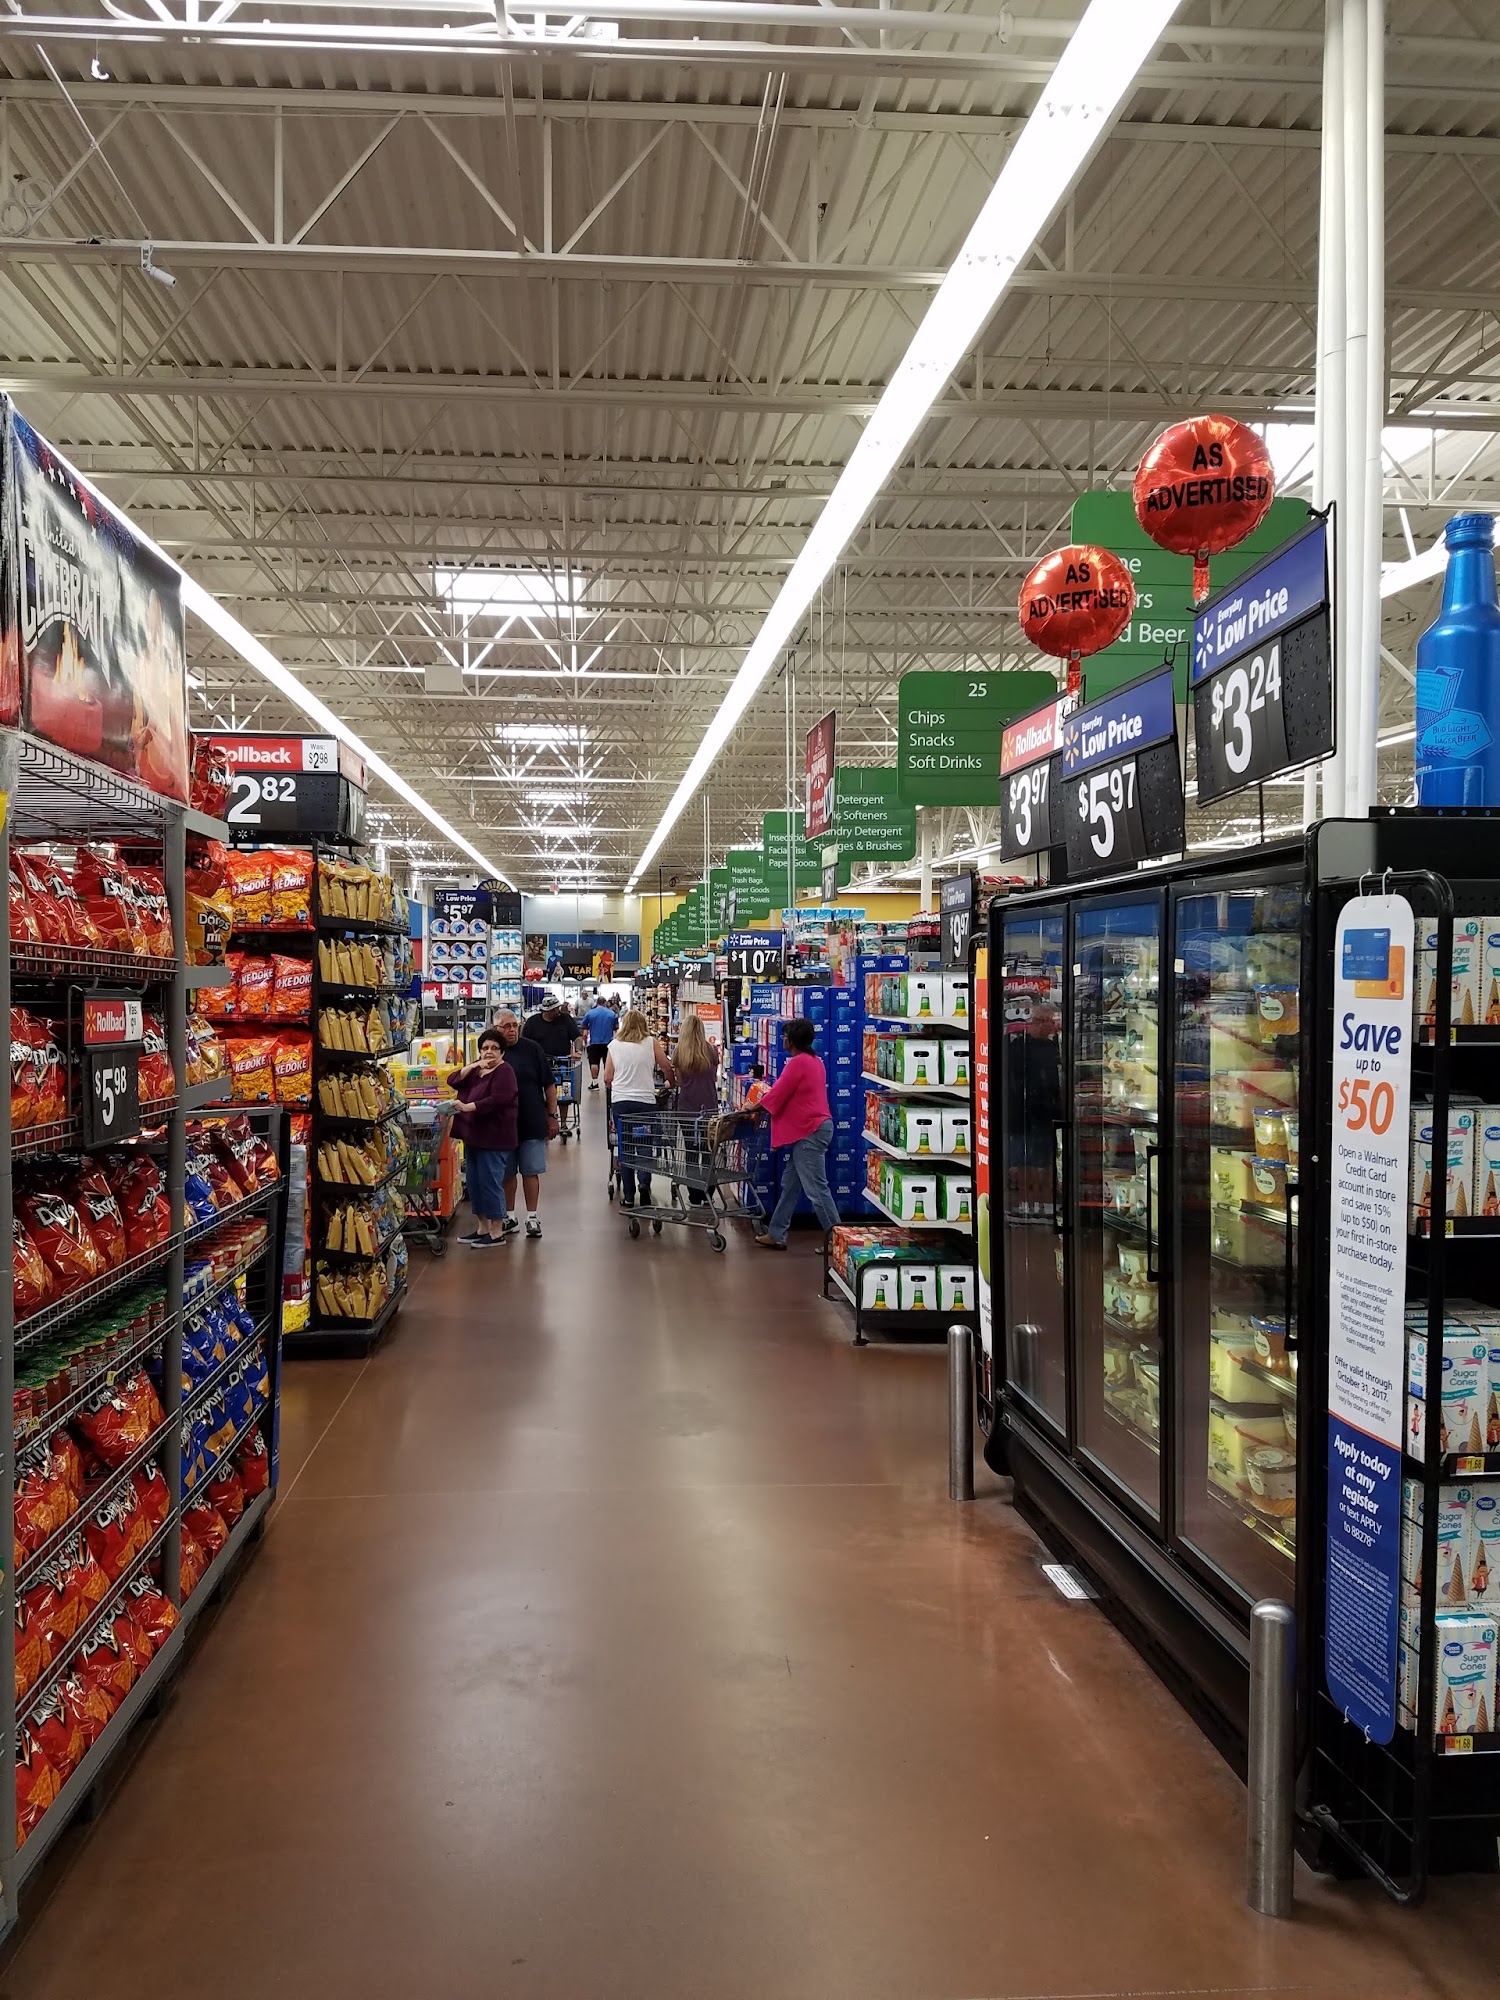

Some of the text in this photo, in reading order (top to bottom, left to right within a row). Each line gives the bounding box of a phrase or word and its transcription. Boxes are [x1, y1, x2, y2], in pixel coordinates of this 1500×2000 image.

[1193, 442, 1223, 471] AS
[1147, 476, 1268, 512] ADVERTISED
[1065, 562, 1090, 585] AS
[1029, 589, 1129, 619] ADVERTISED
[1218, 597, 1243, 623] Everyday
[1217, 587, 1288, 656] Low Price
[1140, 623, 1186, 643] Beer
[968, 683, 988, 697] 25
[908, 711, 945, 727] Chips
[1082, 715, 1103, 732] Everyday
[909, 733, 955, 747] Snacks
[1015, 718, 1053, 757] Rollback
[1082, 713, 1143, 759] Low Price
[310, 743, 326, 751] Was:
[909, 755, 982, 769] Soft Drinks
[837, 795, 884, 807] Detergent
[844, 811, 888, 820] Softeners
[855, 827, 902, 838] Detergent
[769, 846, 788, 854] Facia
[813, 841, 903, 853] Spges & Brushes
[769, 859, 788, 868] Pape
[749, 877, 763, 885] Bags
[1468, 923, 1476, 932] 12
[740, 938, 770, 946] Low Price
[1452, 946, 1470, 955] ugar
[568, 966, 592, 975] YEAR
[1340, 1012, 1402, 1055] Save
[1356, 1058, 1381, 1073] up to
[1461, 1116, 1469, 1125] 12
[1338, 1144, 1398, 1168] Open a Walmart
[1346, 1162, 1387, 1182] Credit Card
[1338, 1179, 1396, 1202] account in store
[1341, 1196, 1391, 1218] and save 15%
[1341, 1210, 1391, 1235] (up to $50) on
[1336, 1226, 1397, 1254] your first in-store
[1337, 1243, 1394, 1272] purchase today.
[1475, 1346, 1484, 1355] 12
[1335, 1355, 1392, 1390] Offer valid through
[1453, 1369, 1478, 1380] Sugar
[1338, 1370, 1388, 1402] October 31, 2017.
[1450, 1378, 1478, 1386] Cones
[1333, 1434, 1391, 1480] Apply today
[1345, 1465, 1376, 1494] at any
[1342, 1483, 1379, 1515] register
[1339, 1502, 1382, 1535] or text APPLY
[1438, 1512, 1462, 1521] Sugar
[1343, 1520, 1350, 1533] to
[1485, 1631, 1493, 1639] 12
[1463, 1654, 1487, 1664] Sugar
[1460, 1663, 1486, 1671] Cones
